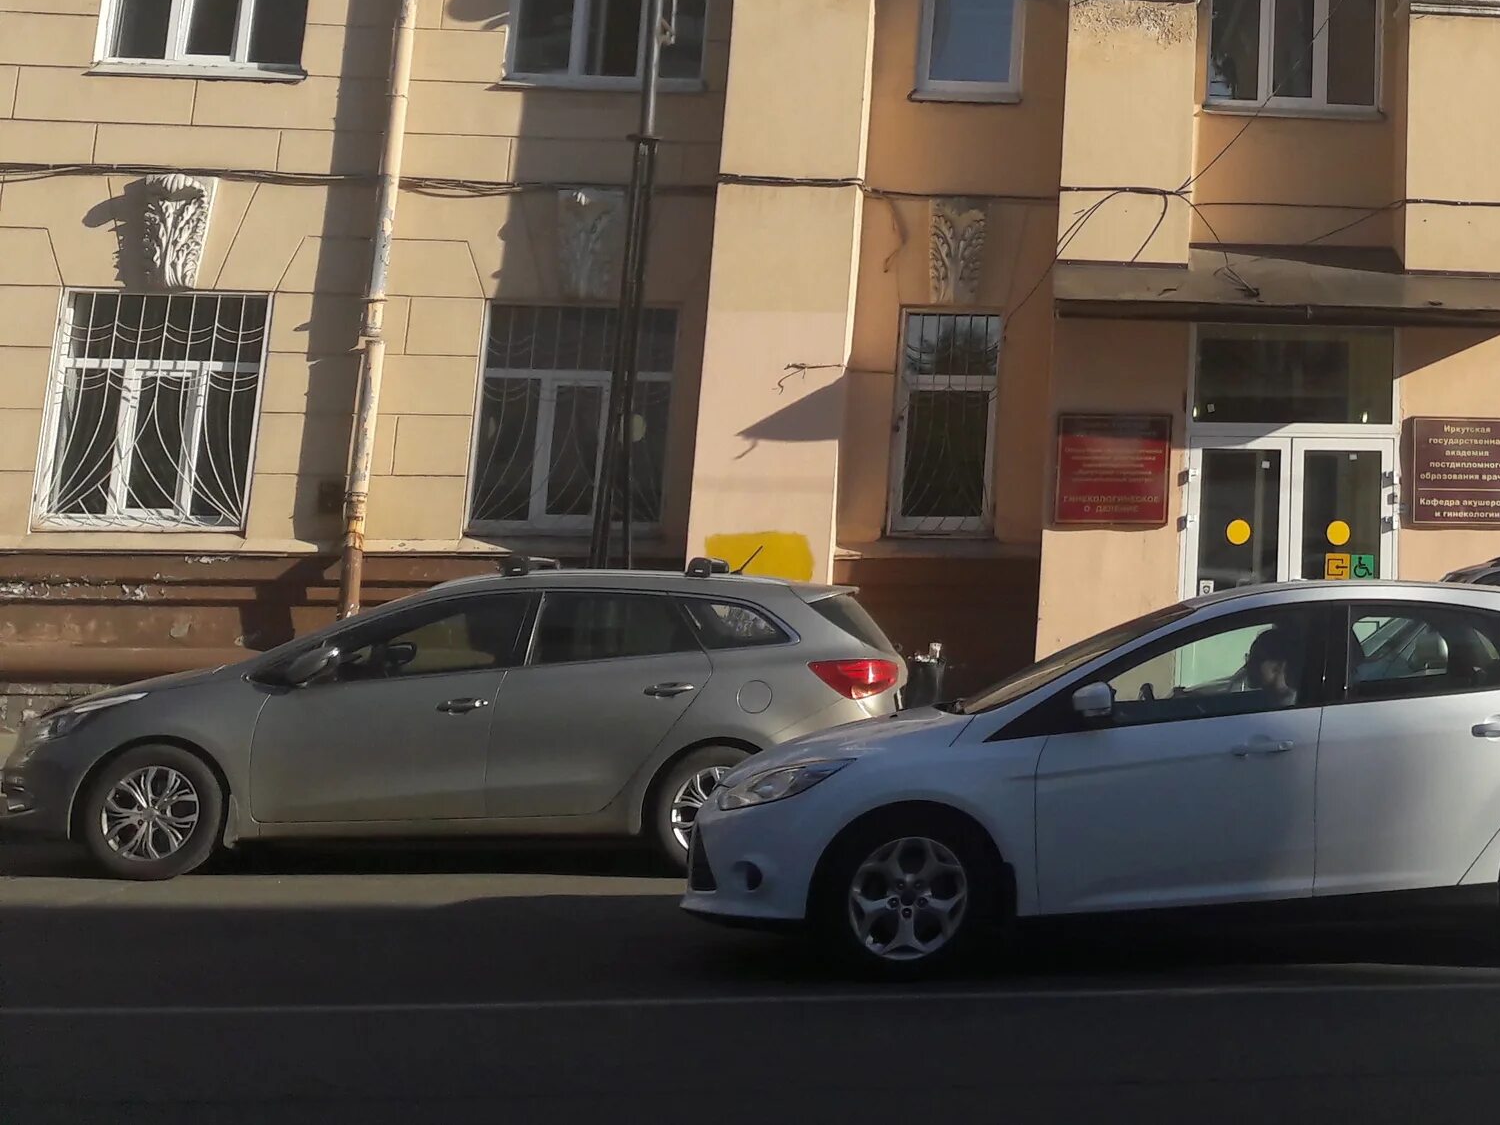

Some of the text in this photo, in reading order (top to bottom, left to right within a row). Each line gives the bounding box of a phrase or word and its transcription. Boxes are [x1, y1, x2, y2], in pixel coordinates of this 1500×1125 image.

[1443, 424, 1491, 435] Иркутская
[1445, 449, 1490, 457] академия
[1420, 471, 1480, 481] образования
[1419, 498, 1460, 507] Кафедра
[1443, 511, 1500, 519] гинекологии
